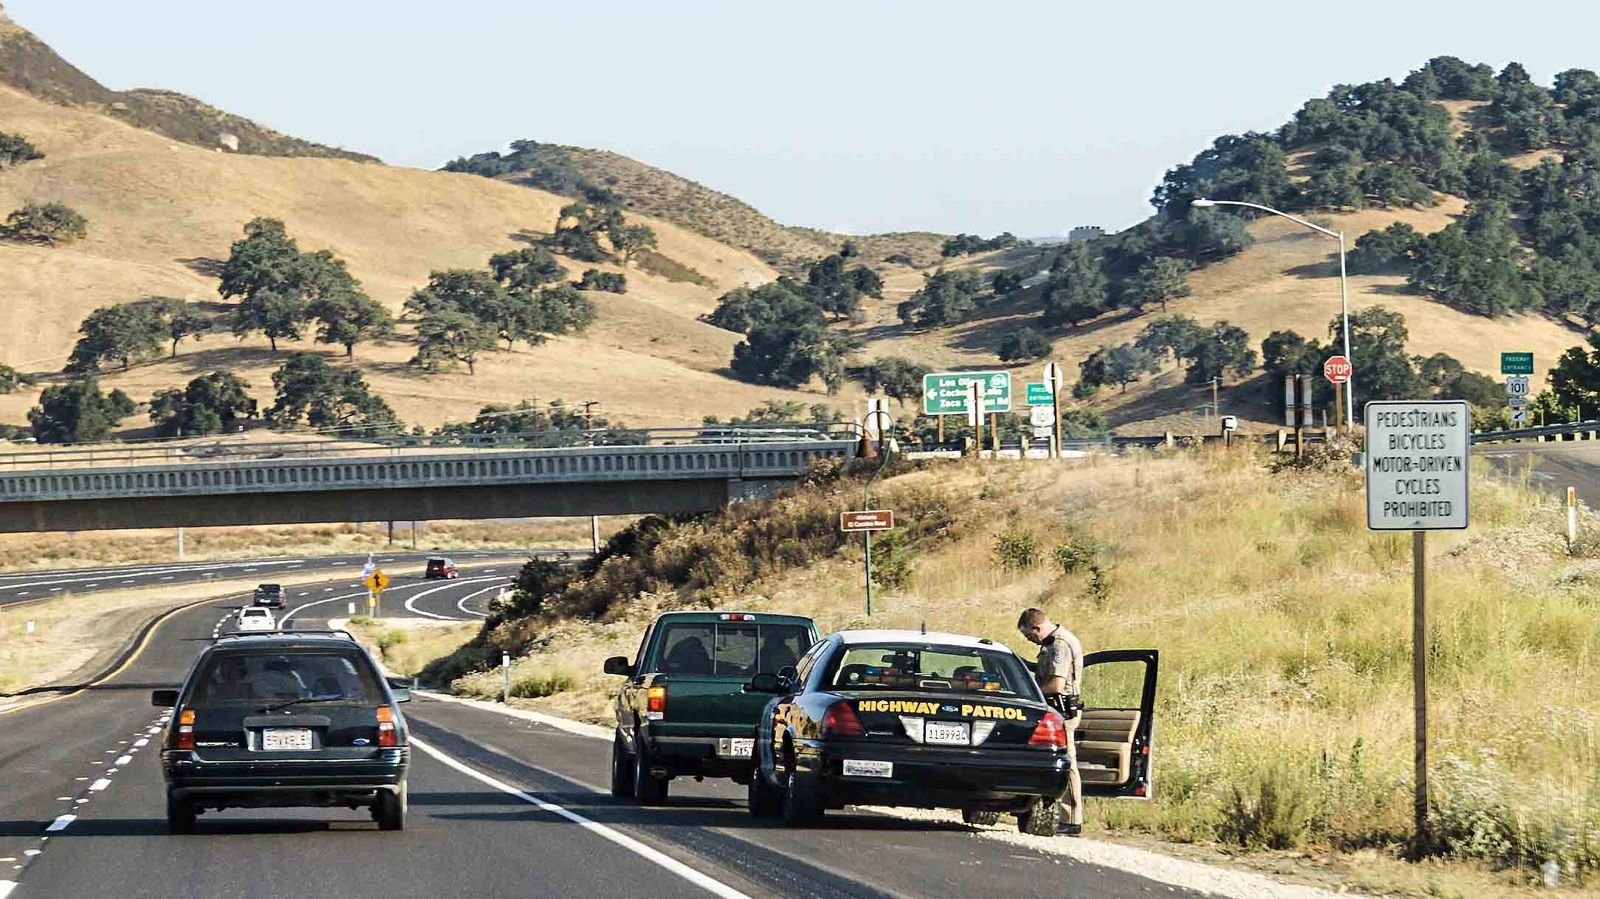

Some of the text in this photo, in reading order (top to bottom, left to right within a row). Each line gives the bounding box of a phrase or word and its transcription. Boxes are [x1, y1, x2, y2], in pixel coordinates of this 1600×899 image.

[1326, 363, 1349, 375] STOP
[939, 379, 956, 387] Los
[1510, 383, 1525, 393] 101
[1376, 411, 1457, 428] PEDESTRIANS
[1388, 434, 1446, 450] BICYCLES
[1372, 456, 1462, 473] MOTOR-DRIVEN
[1395, 478, 1441, 495] CYCLES
[1383, 501, 1453, 518] PROHIBITED
[858, 700, 1027, 721] HIGHWAY PATROL
